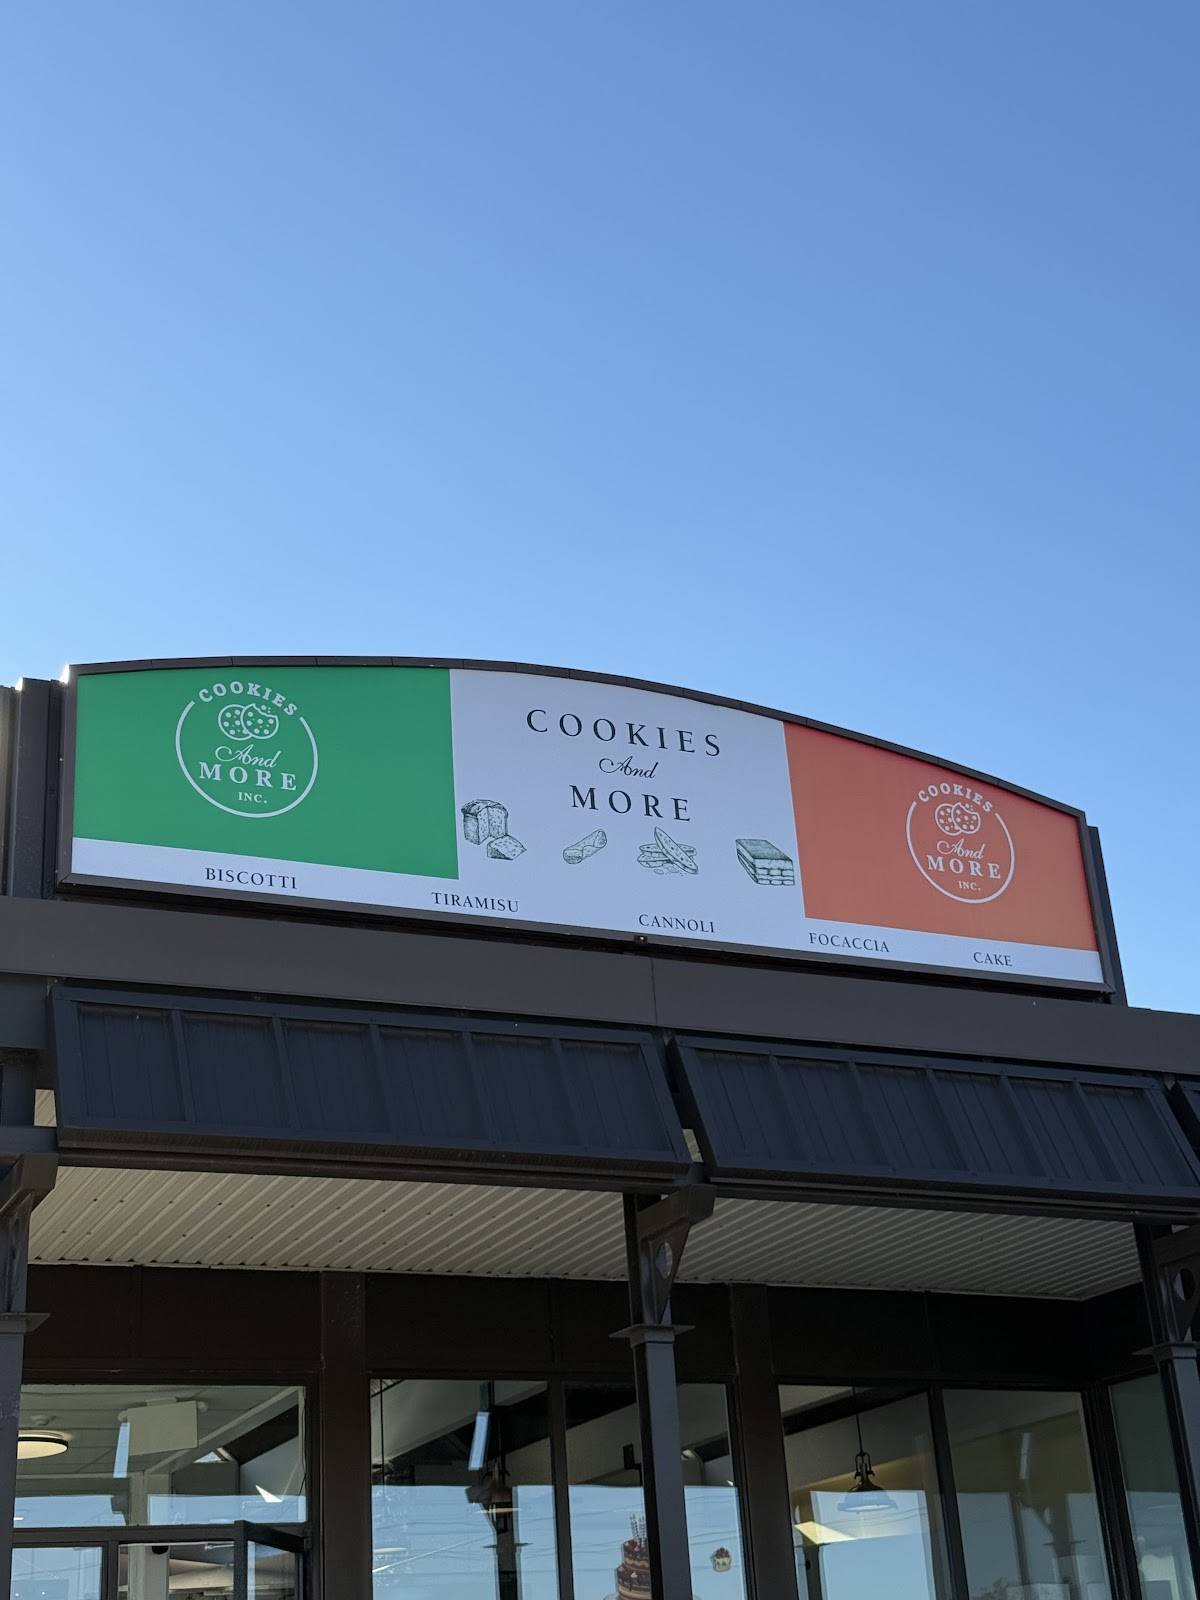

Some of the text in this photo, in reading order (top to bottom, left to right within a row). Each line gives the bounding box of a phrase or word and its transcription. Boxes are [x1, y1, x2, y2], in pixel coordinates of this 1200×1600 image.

[198, 681, 298, 716] COOKIES
[526, 709, 721, 757] COOKIES
[215, 743, 282, 768] And
[198, 761, 297, 791] MORE
[598, 755, 659, 780] And
[238, 791, 268, 804] INC.
[569, 784, 691, 822] MORE
[918, 783, 993, 813] COOKIES
[936, 838, 986, 859] And
[205, 867, 297, 889] BISCOTTI
[926, 855, 1001, 879] MORE
[958, 880, 981, 891] INC.
[431, 892, 520, 913] TIRAMISU
[638, 914, 715, 933] CANNOLI
[808, 932, 890, 953] FOCACCIA
[973, 952, 1013, 967] CAKE
